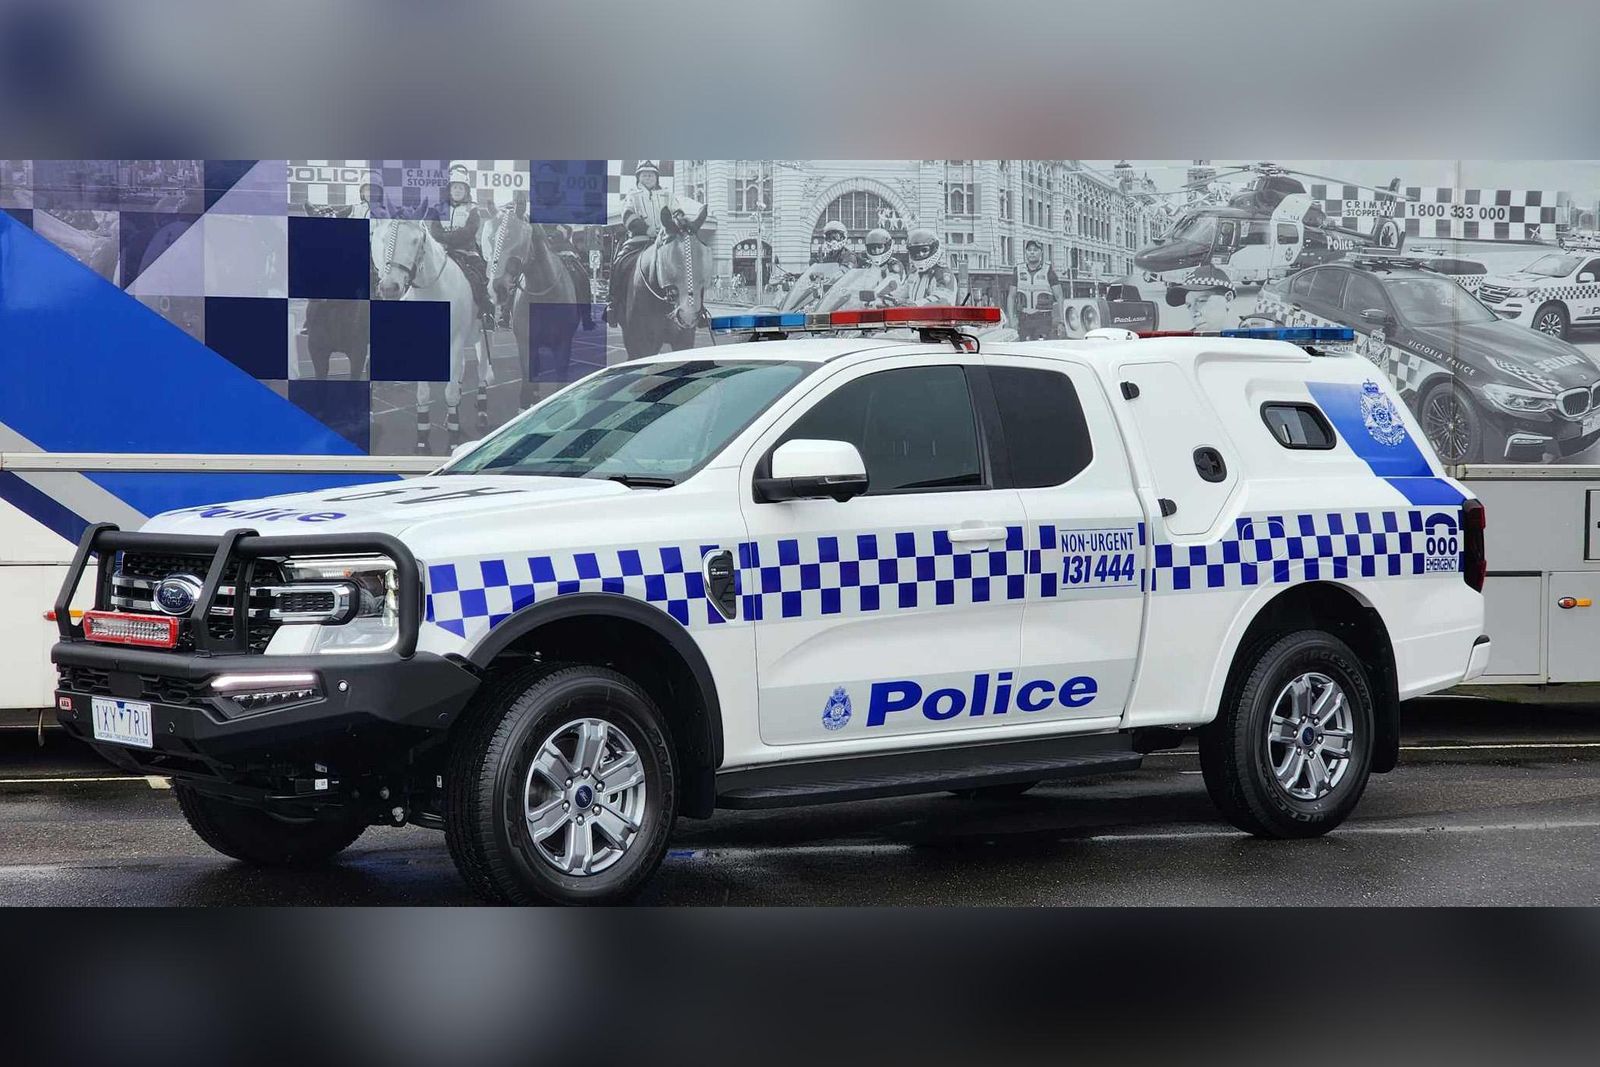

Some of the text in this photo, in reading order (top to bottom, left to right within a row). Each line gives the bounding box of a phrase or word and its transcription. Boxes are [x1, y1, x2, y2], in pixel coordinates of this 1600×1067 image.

[287, 167, 362, 182] OLIC
[406, 169, 444, 178] CRIM
[482, 173, 524, 187] 1800
[1345, 209, 1381, 217] STOPPE
[1410, 203, 1506, 221] 1800 333 000
[1325, 235, 1355, 251] Police
[1407, 339, 1443, 359] VICTORIA
[1060, 531, 1135, 552] NON-URGENT
[1426, 536, 1458, 556] 000
[1426, 558, 1457, 571] EMERGENCY
[866, 671, 1099, 728] Police
[95, 704, 149, 736] 1XY 7RU
